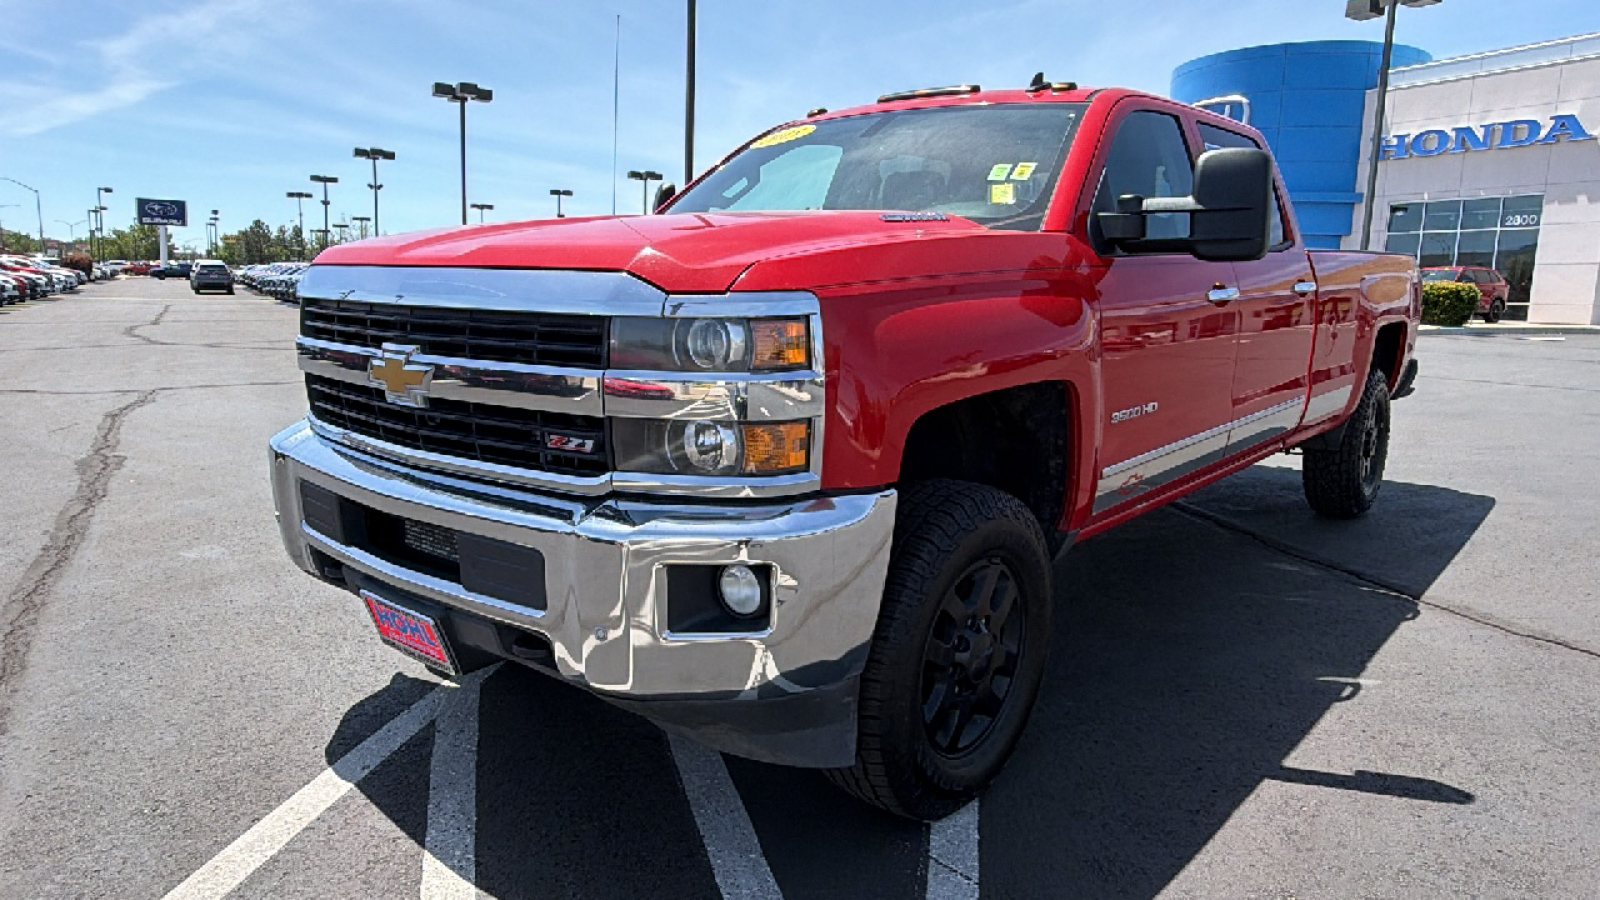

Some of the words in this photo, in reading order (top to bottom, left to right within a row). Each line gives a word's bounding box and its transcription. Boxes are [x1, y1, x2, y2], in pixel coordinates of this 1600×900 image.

[1370, 113, 1593, 161] HONDA
[1505, 214, 1538, 226] 2800
[1142, 401, 1159, 415] HD
[547, 434, 595, 453] Z71
